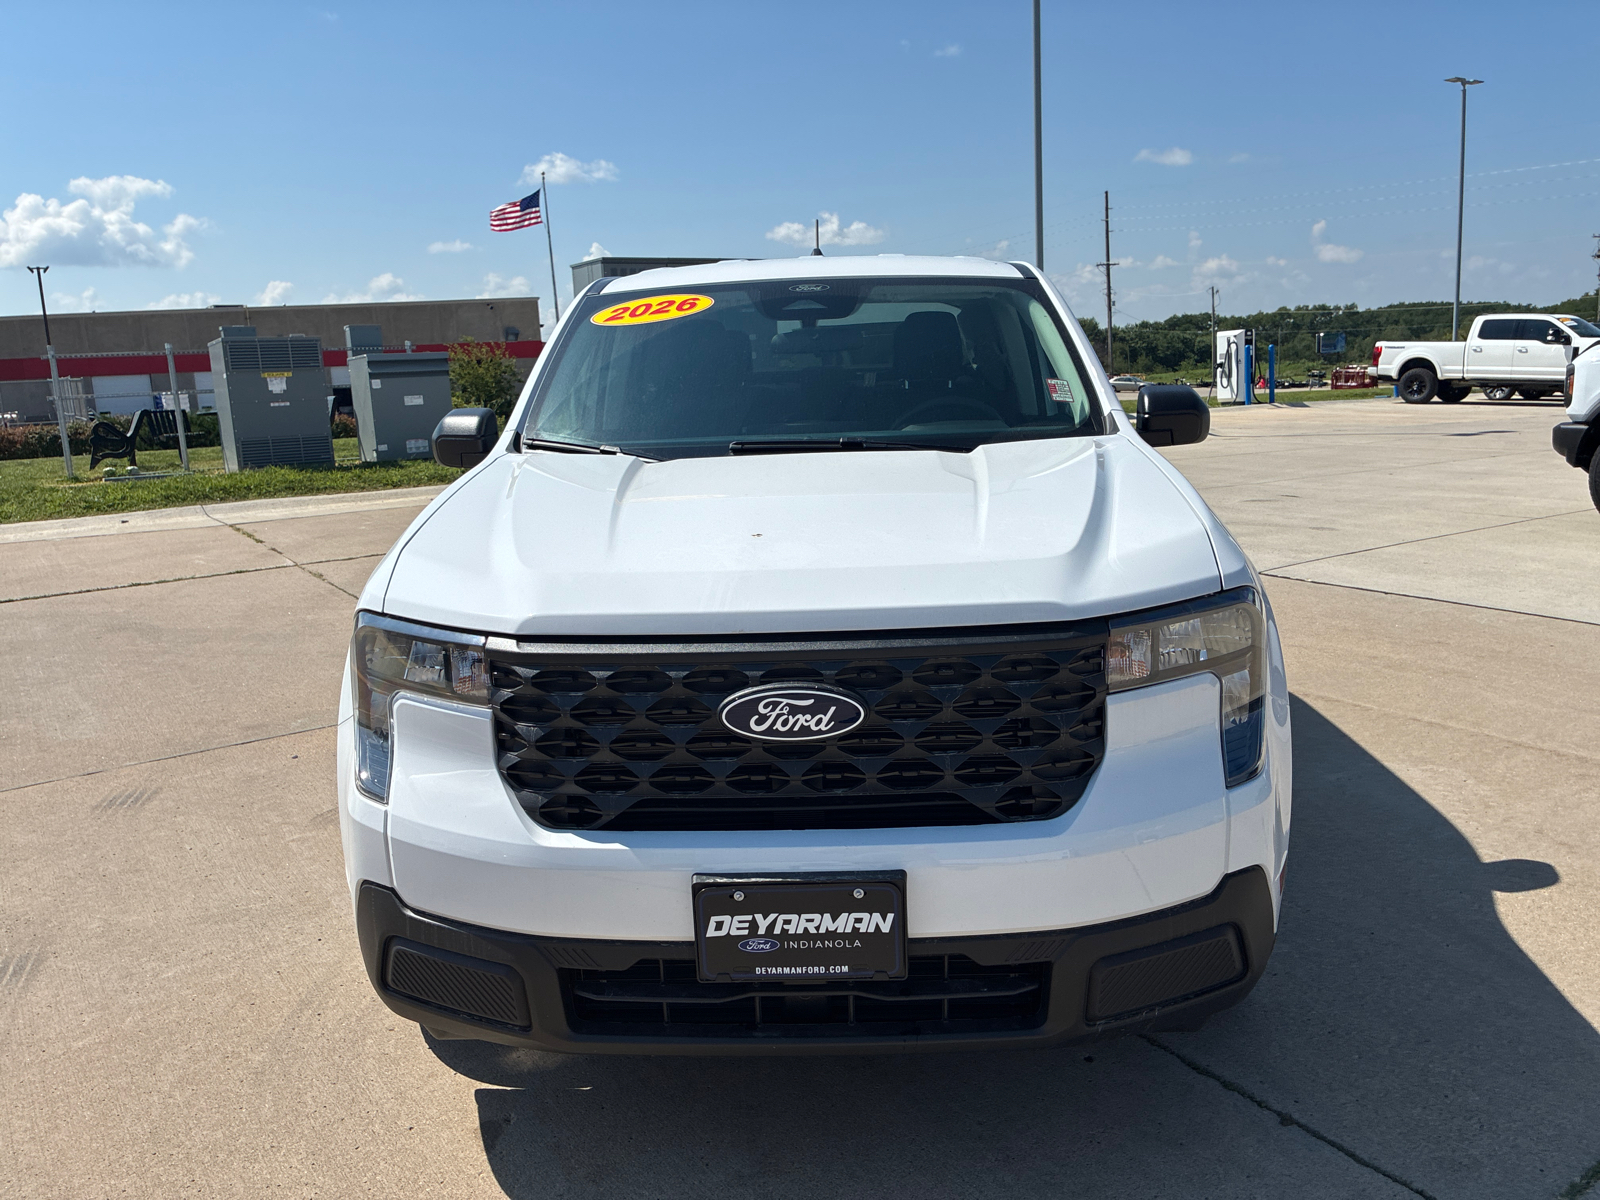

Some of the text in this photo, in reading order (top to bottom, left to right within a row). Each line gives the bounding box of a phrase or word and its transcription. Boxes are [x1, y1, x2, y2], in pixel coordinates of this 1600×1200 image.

[603, 298, 701, 322] 2026
[750, 698, 836, 732] Ford
[706, 912, 894, 938] DEYARMAN
[746, 940, 862, 950] Ford INDIANOLA
[756, 966, 848, 974] DEYARMANFORD.COM
